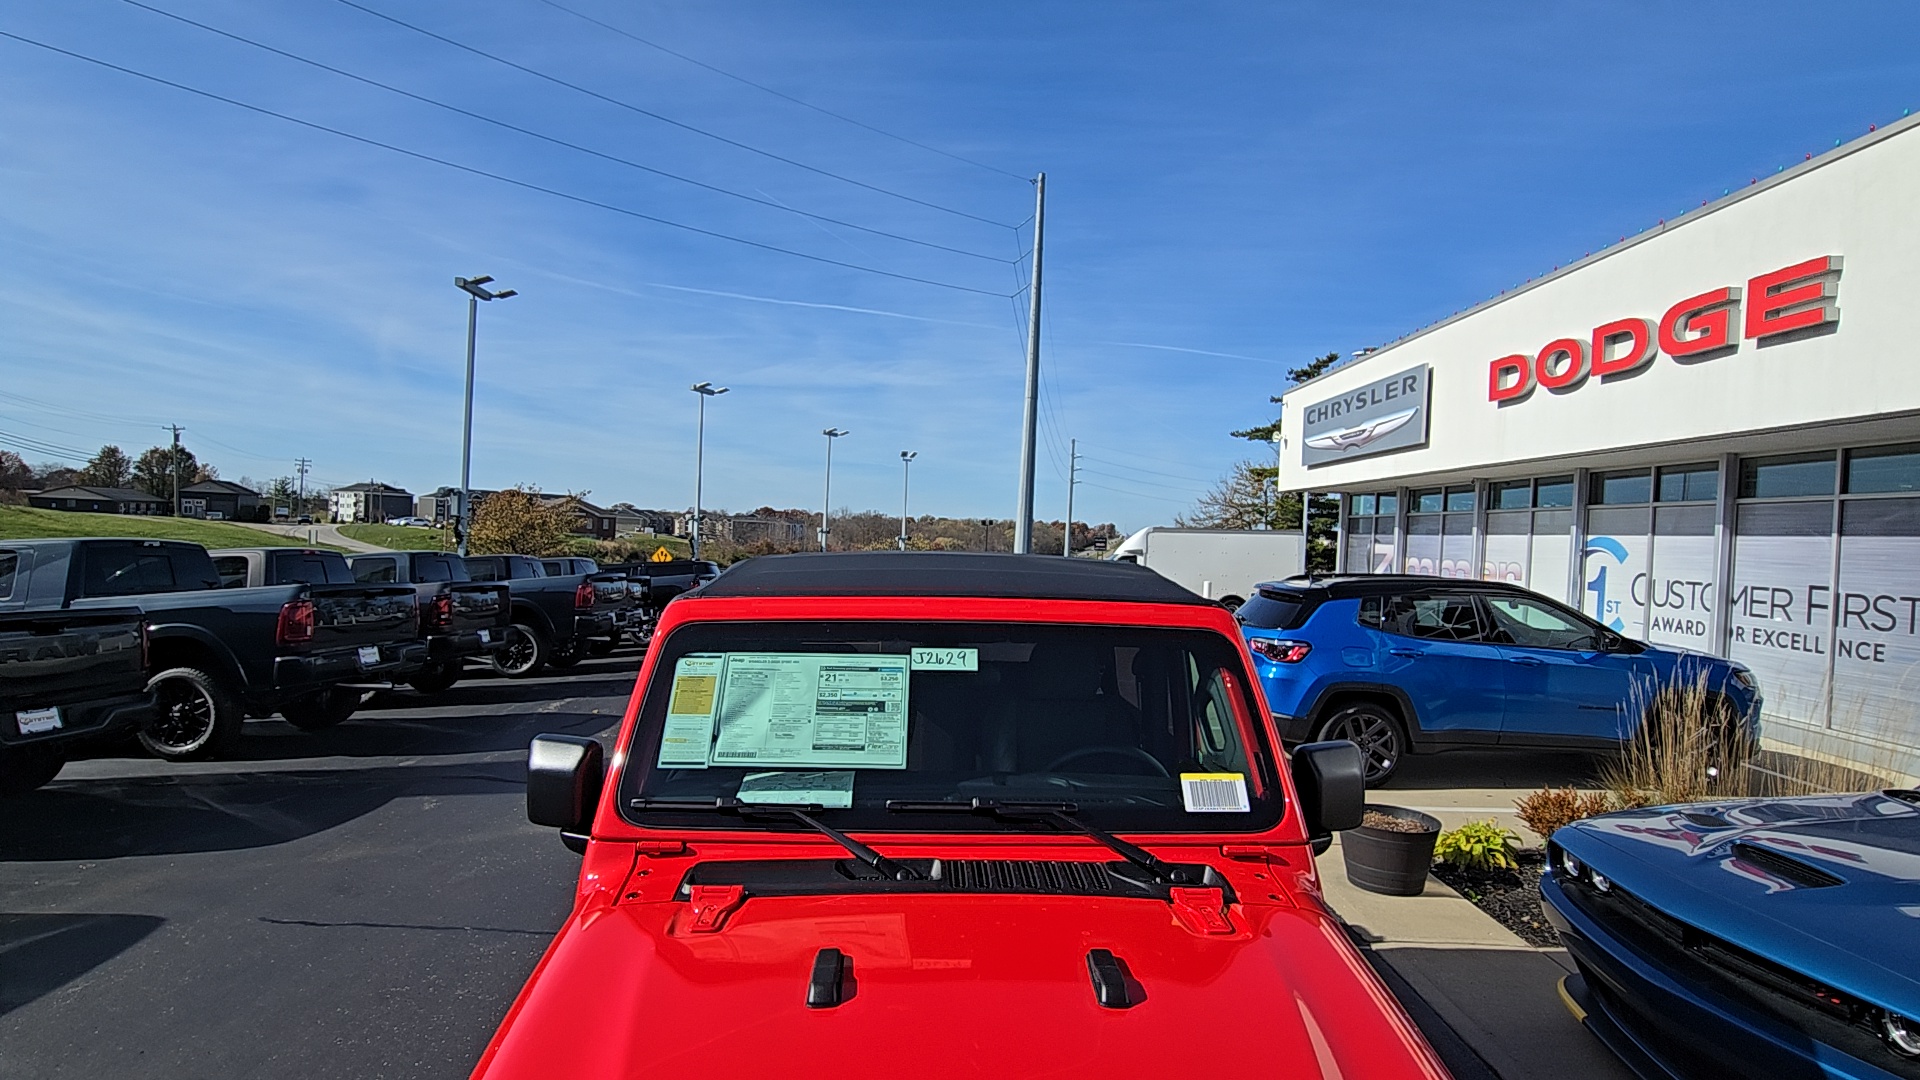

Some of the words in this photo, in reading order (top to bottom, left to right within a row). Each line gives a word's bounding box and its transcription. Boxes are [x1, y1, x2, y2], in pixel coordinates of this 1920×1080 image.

[1488, 255, 1843, 407] DODGE
[1306, 374, 1418, 425] CHRYSLER
[1806, 585, 1920, 635] FIRST
[913, 651, 967, 668] J2629
[1651, 616, 1706, 636] AWARD
[1752, 628, 1886, 663] EXCELLNCE
[824, 673, 837, 682] 21
